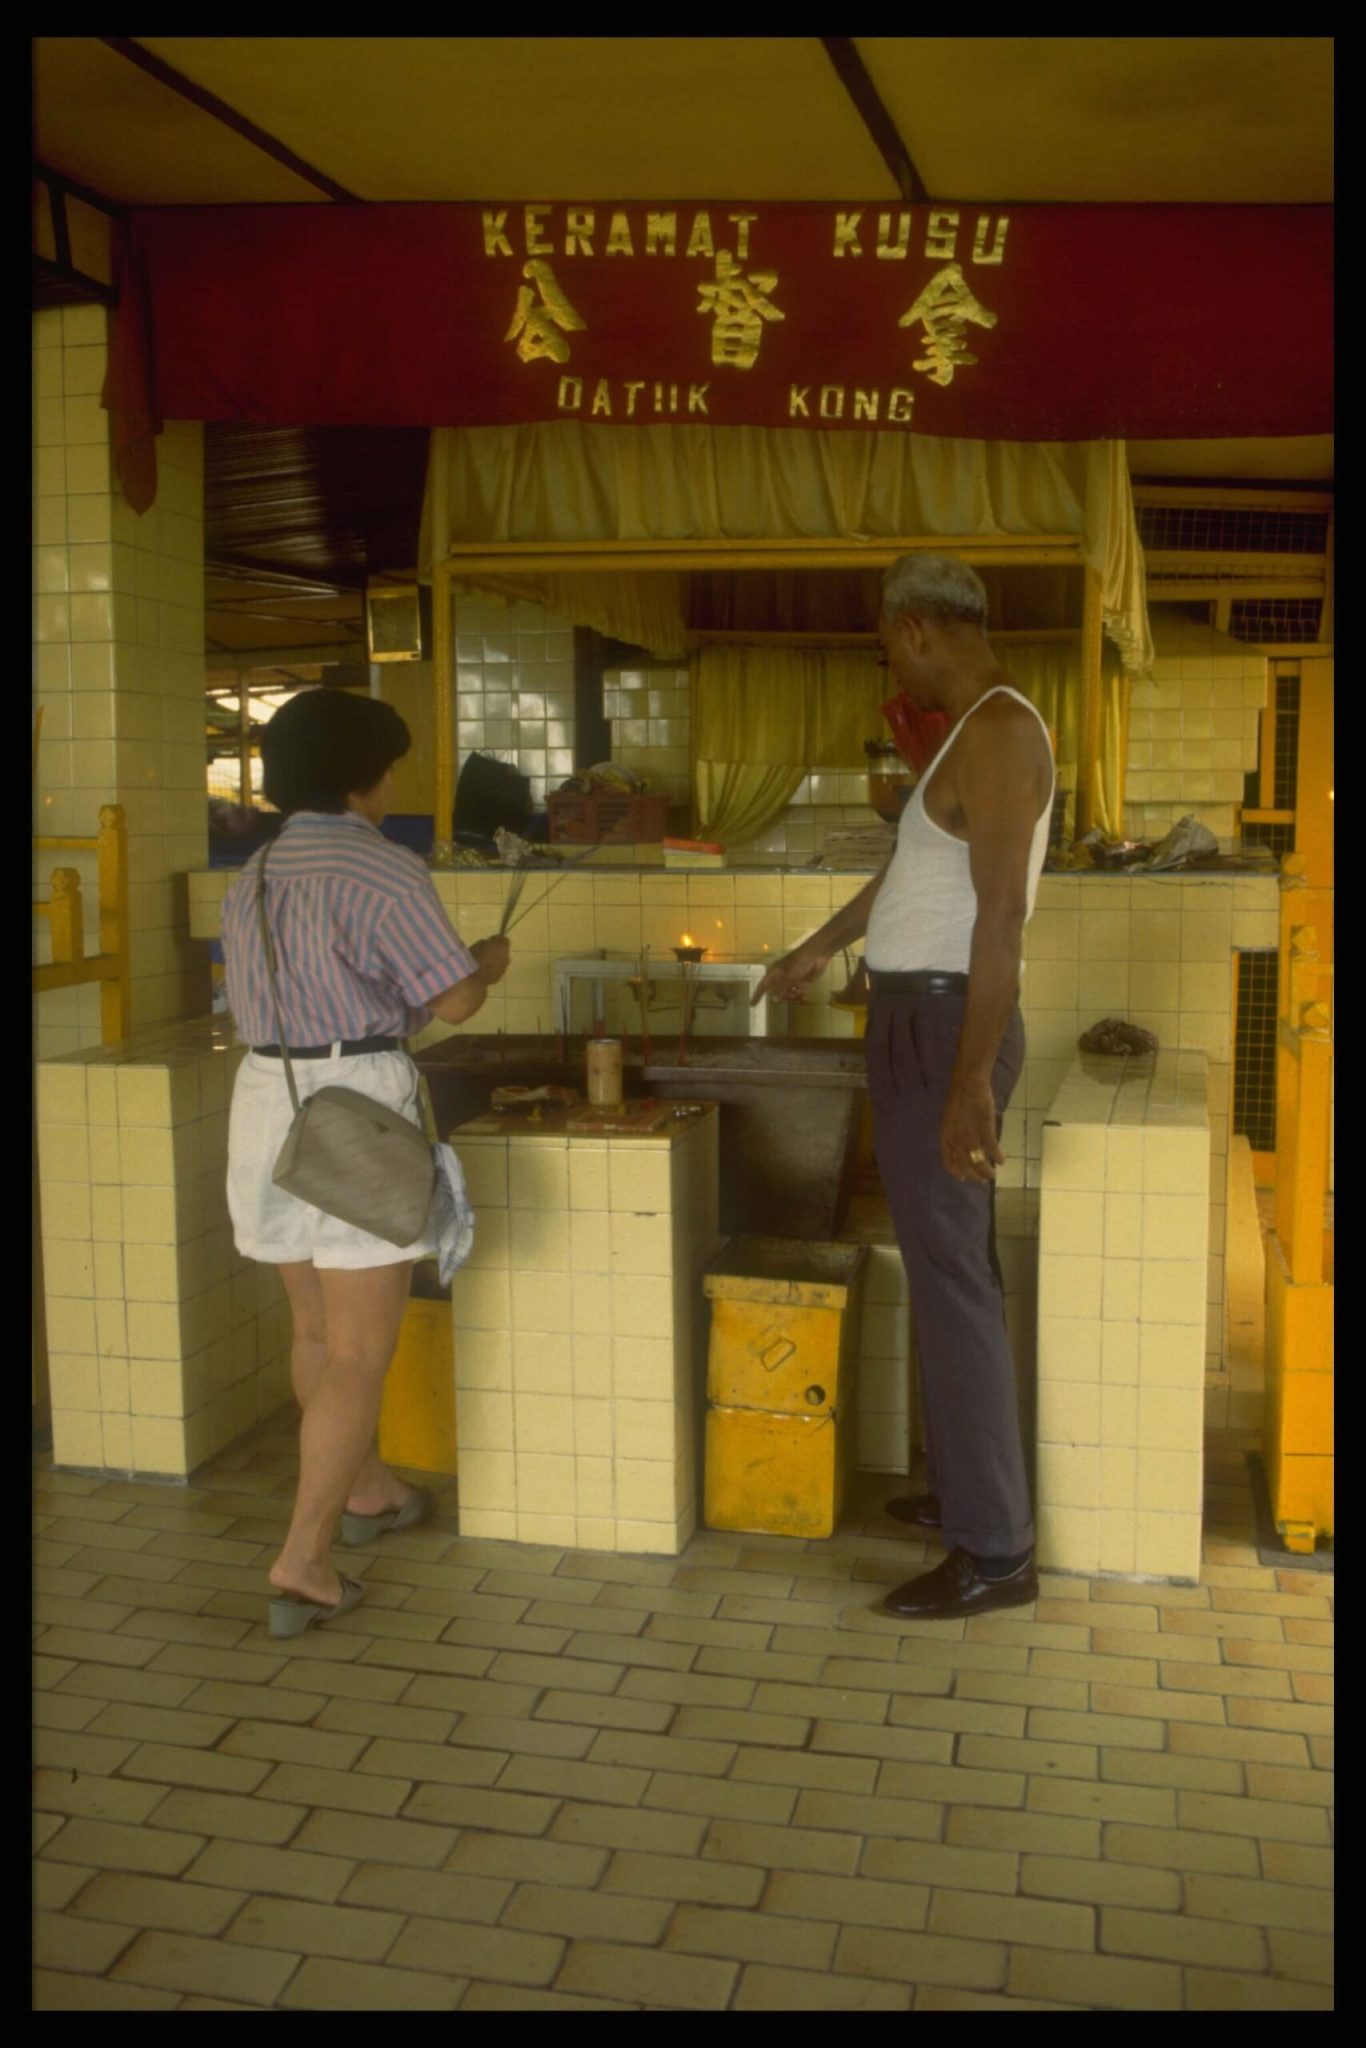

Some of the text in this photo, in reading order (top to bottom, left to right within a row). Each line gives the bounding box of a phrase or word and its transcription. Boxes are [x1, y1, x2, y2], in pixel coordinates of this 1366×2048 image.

[482, 209, 1011, 266] KERAMAT KUSU
[788, 384, 915, 423] KONG
